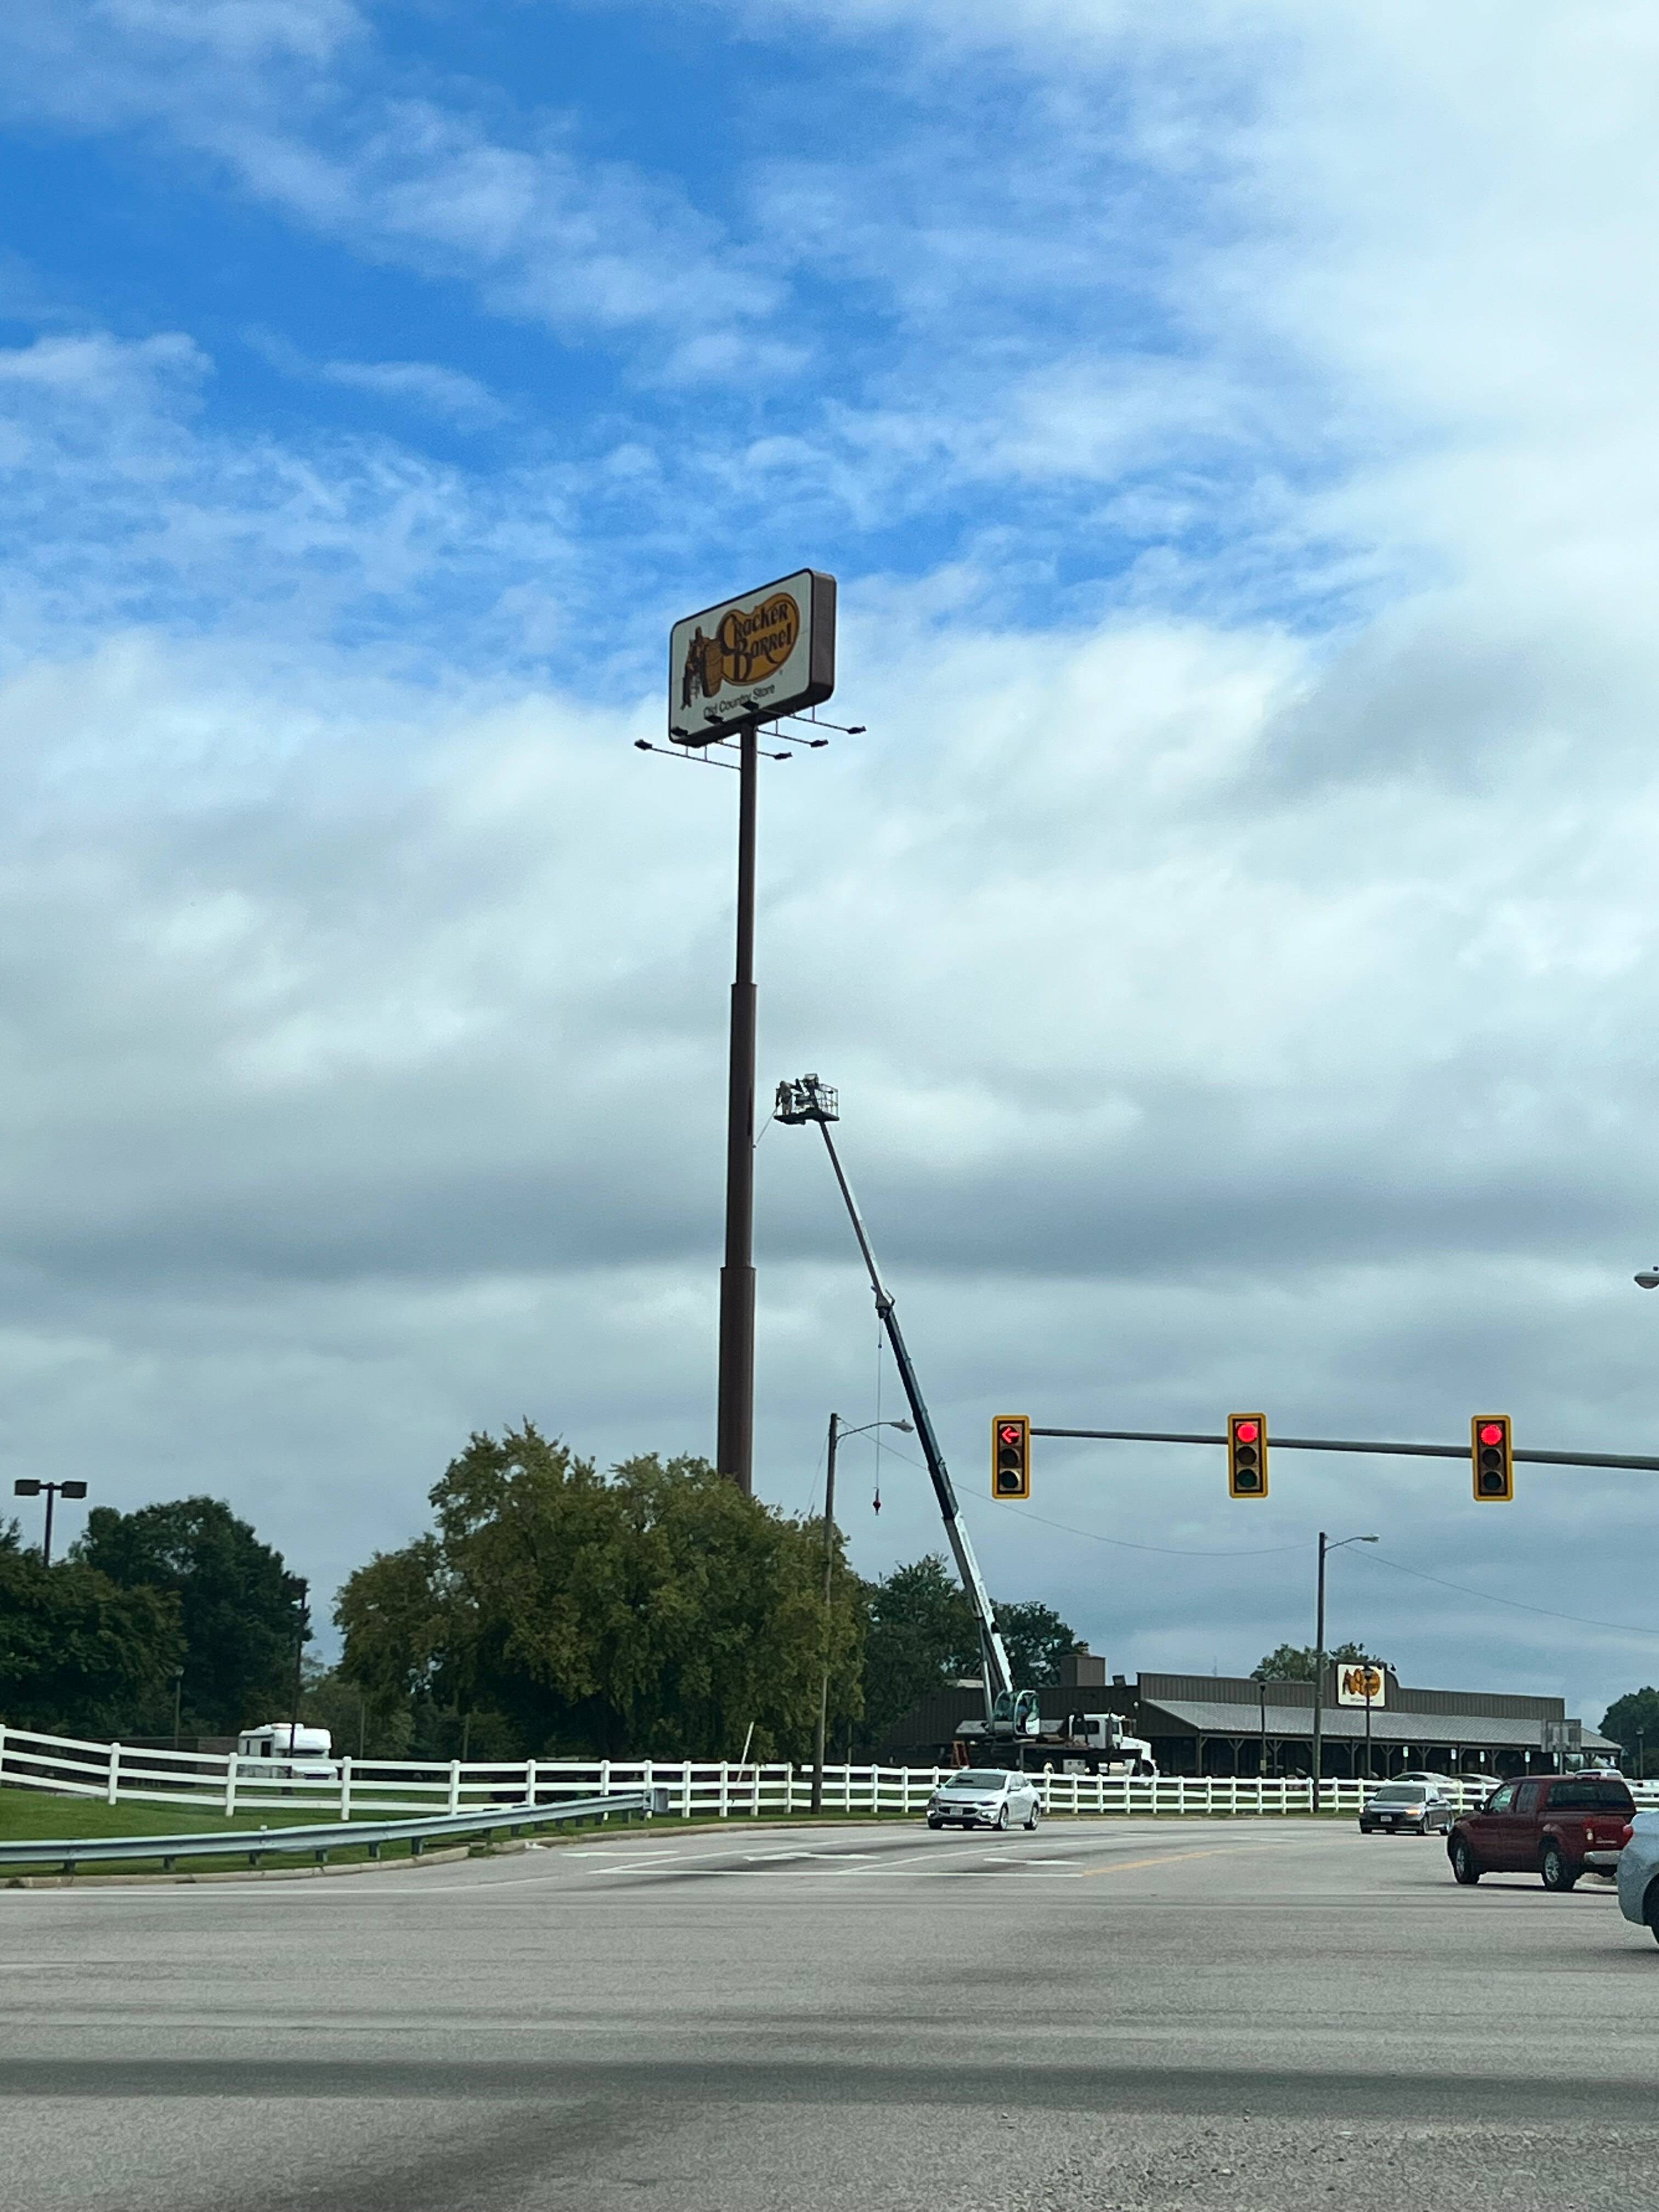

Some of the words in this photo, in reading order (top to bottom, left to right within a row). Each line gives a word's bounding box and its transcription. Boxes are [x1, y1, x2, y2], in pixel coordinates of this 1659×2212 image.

[719, 603, 788, 656] Cracker
[733, 623, 792, 682] Barrel
[703, 702, 718, 717] Old
[753, 684, 775, 701] Store
